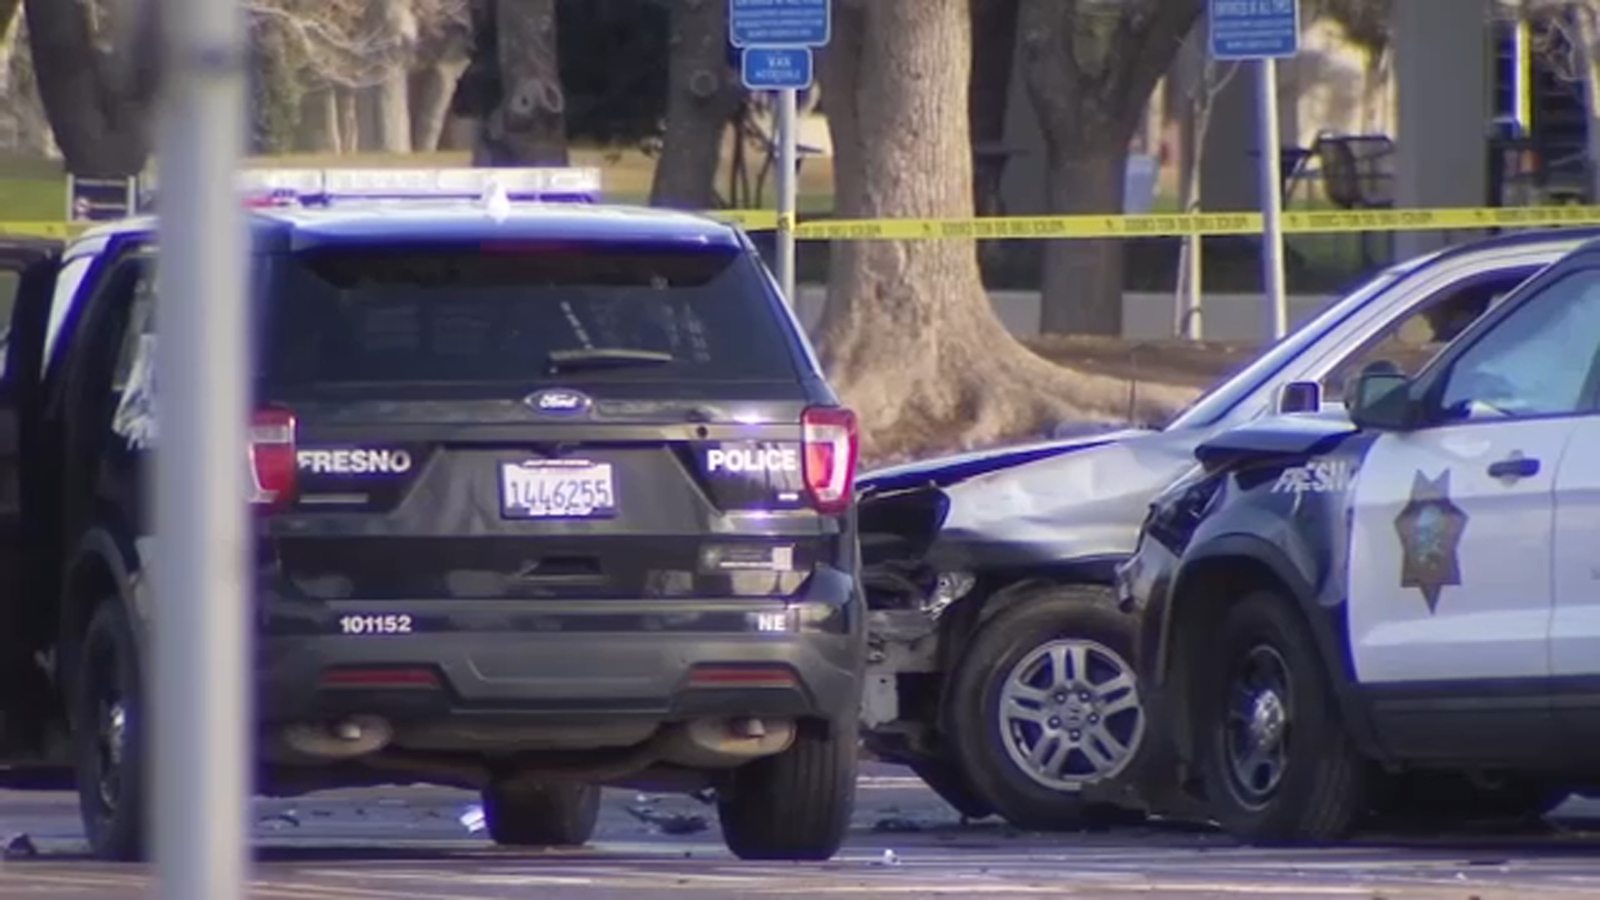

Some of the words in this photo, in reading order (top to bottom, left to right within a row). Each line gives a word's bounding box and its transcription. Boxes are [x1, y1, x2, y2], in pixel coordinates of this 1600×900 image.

[540, 394, 578, 408] Ford
[297, 450, 411, 473] FRESNO
[707, 449, 796, 471] POLICE
[511, 481, 610, 508] 1446255
[340, 614, 412, 633] 101152
[758, 614, 786, 631] NE
